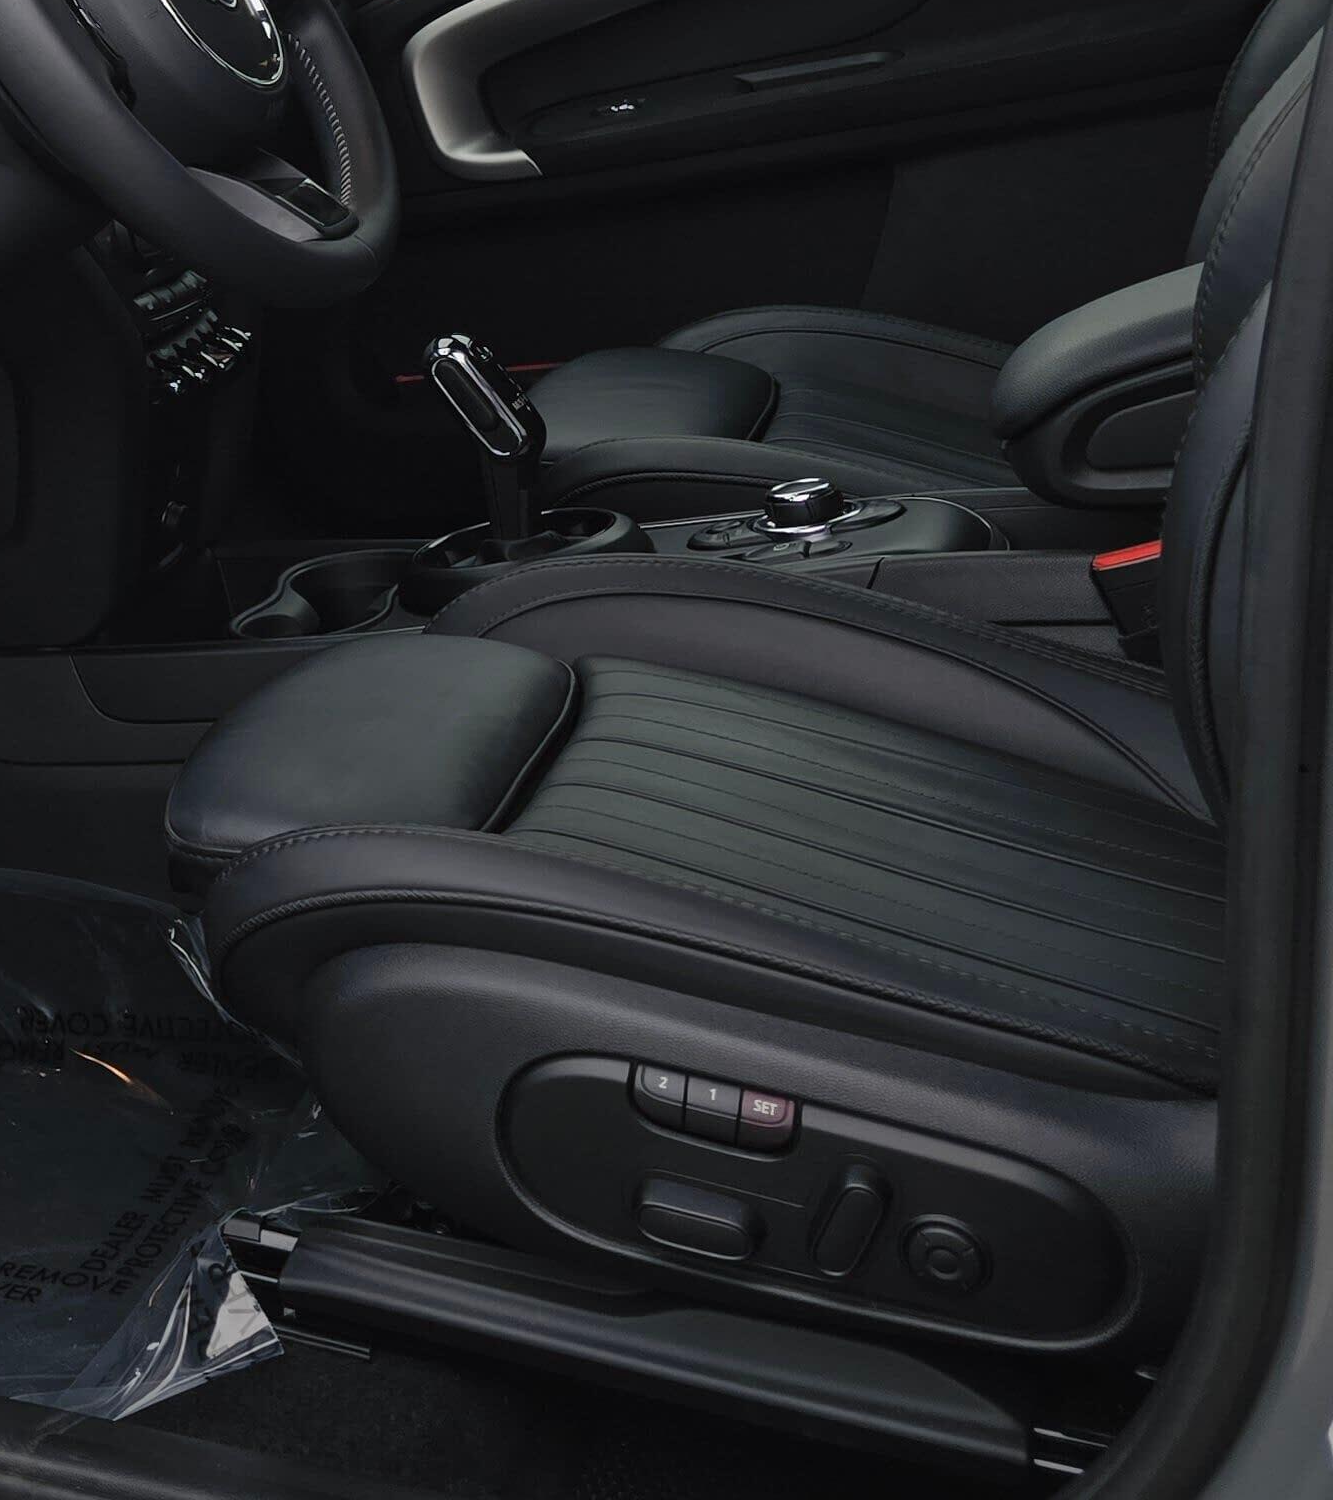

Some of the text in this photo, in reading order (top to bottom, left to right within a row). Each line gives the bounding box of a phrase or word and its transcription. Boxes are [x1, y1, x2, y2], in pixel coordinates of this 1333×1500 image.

[658, 1076, 669, 1089] 2
[708, 1088, 718, 1101] 1
[752, 1099, 779, 1116] SET
[80, 1209, 150, 1272] DEALER
